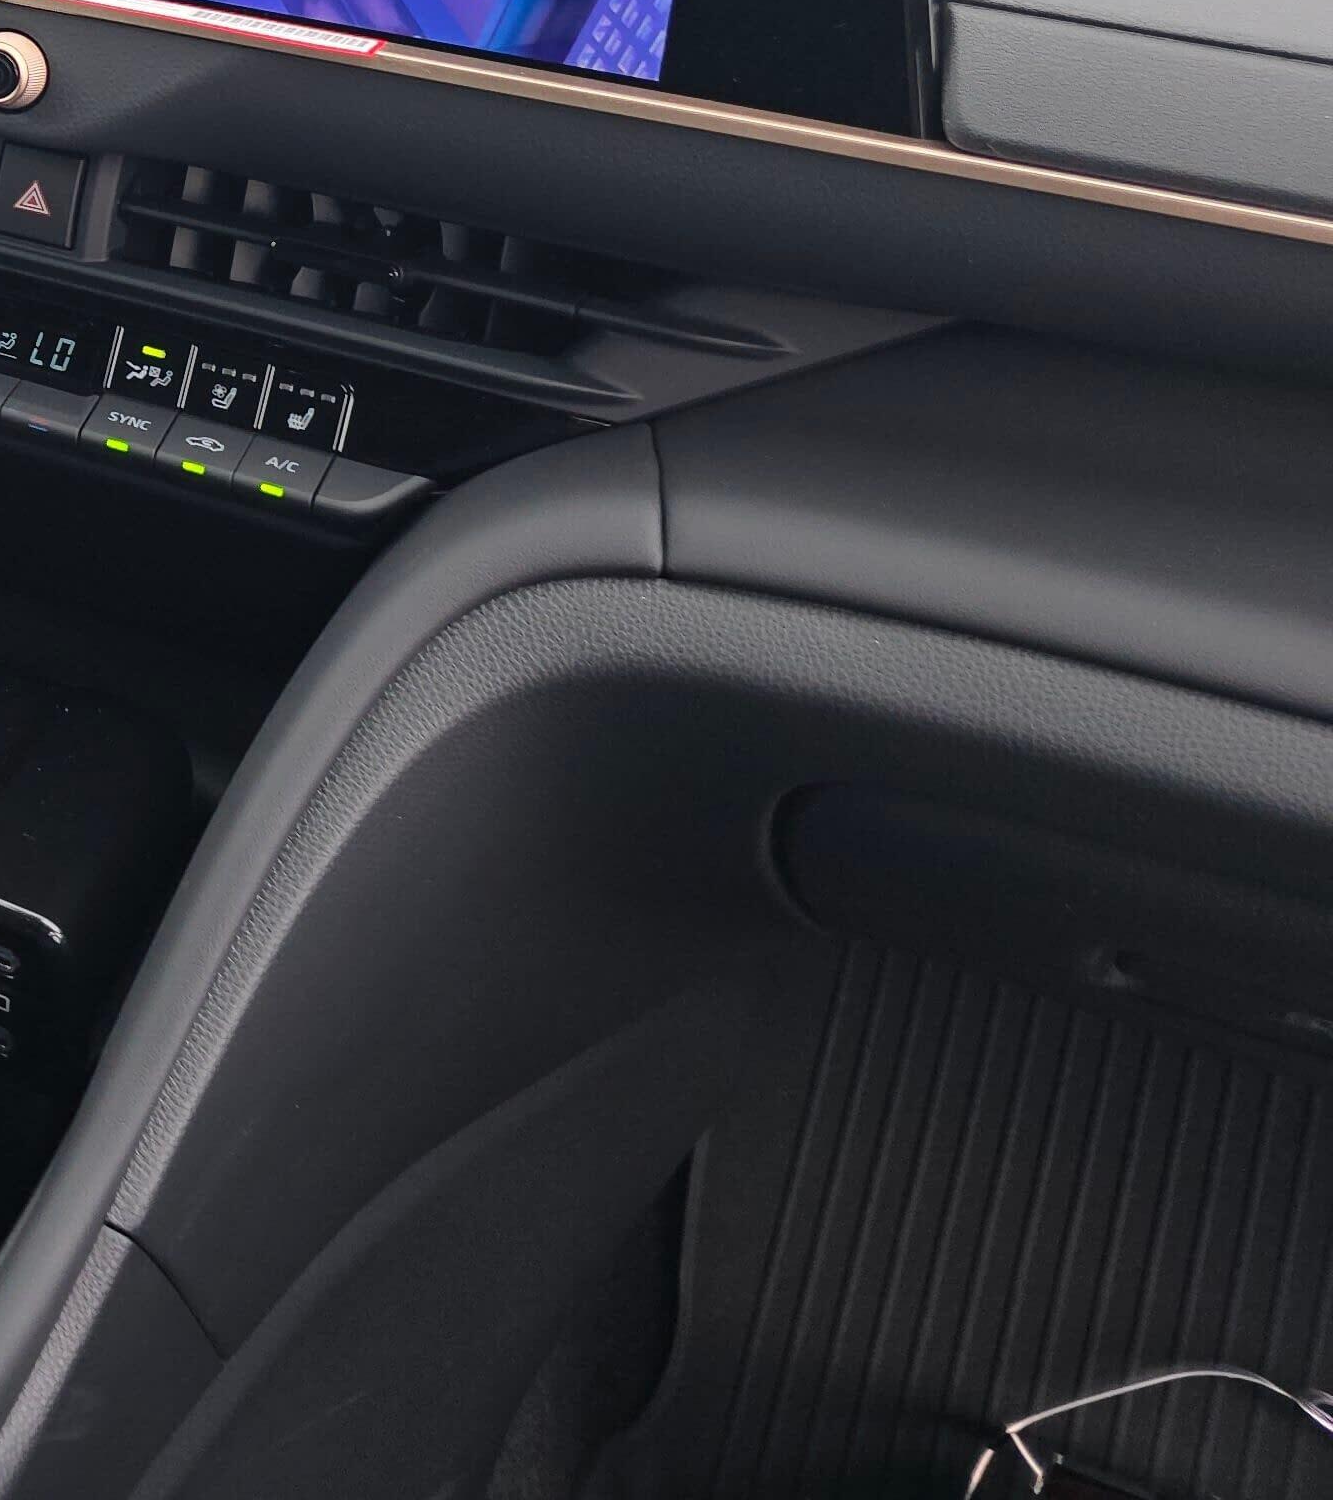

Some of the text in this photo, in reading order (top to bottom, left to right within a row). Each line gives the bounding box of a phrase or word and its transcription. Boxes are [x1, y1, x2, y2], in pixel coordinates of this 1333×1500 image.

[29, 331, 76, 372] LO
[106, 411, 153, 432] SYNC
[264, 455, 301, 474] A/C
